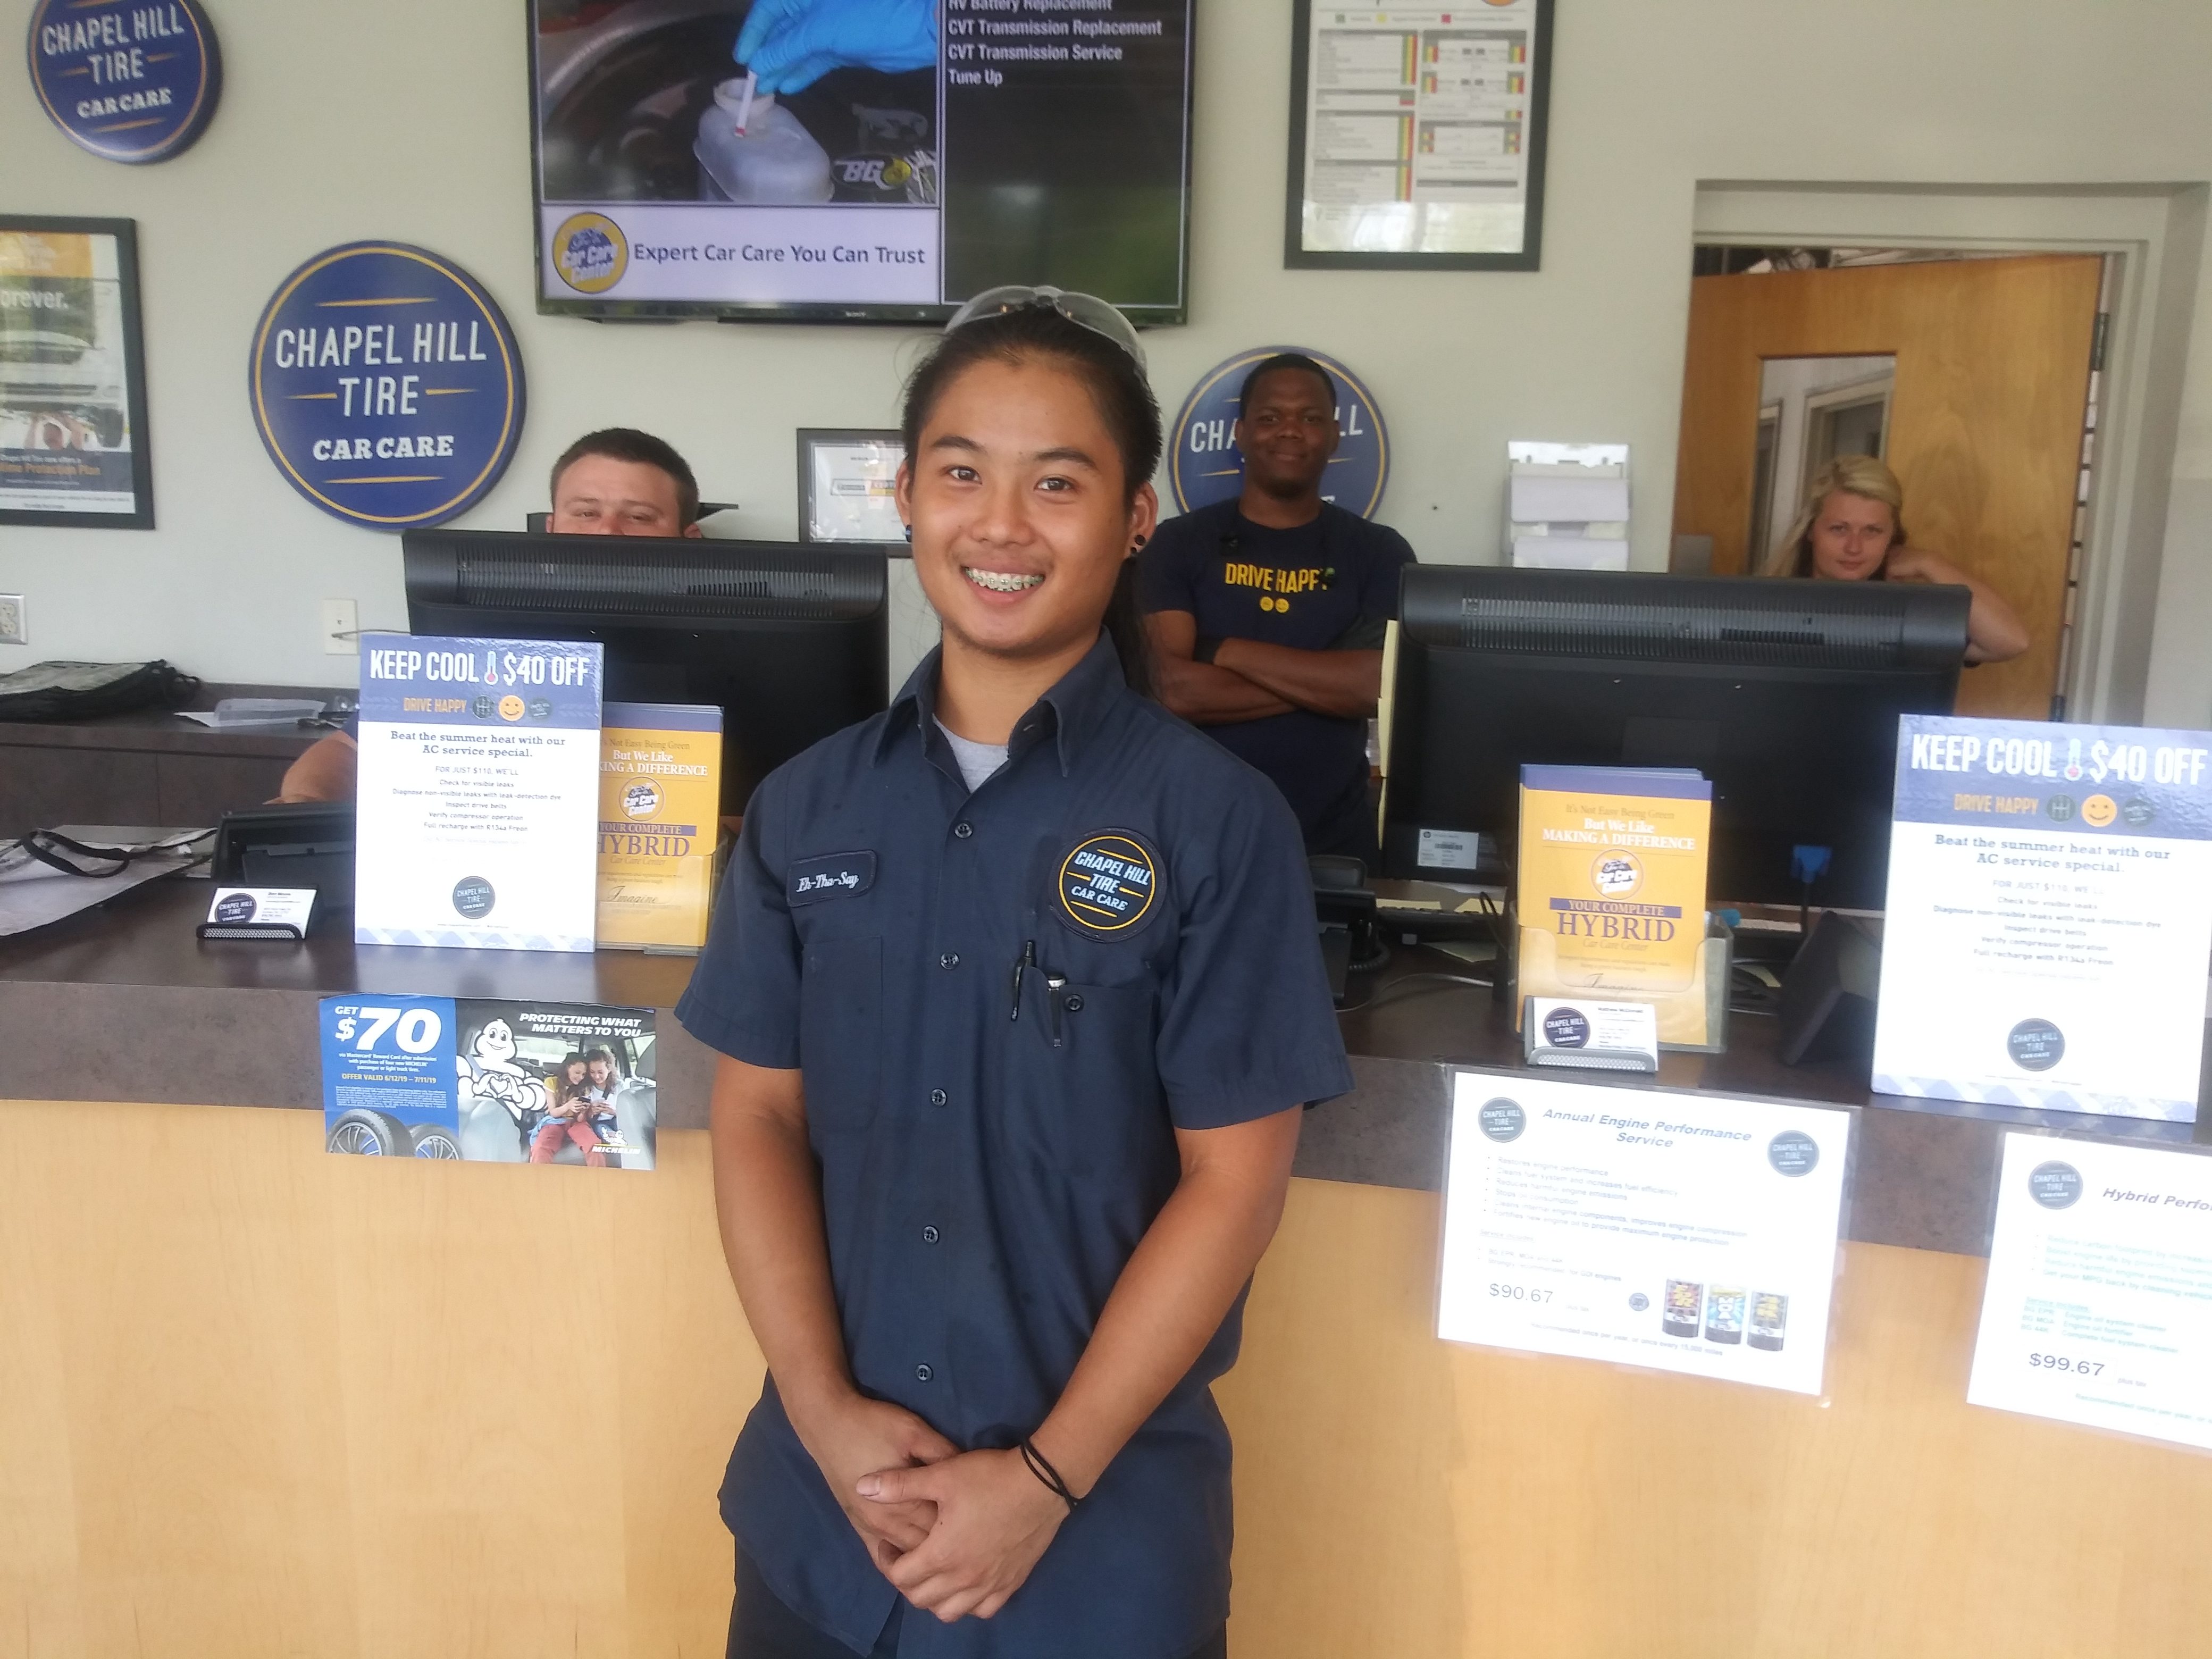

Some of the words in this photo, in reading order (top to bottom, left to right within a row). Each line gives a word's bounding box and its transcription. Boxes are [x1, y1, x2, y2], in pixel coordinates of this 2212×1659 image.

[1023, 0, 1112, 13] Replacement
[42, 13, 130, 55] CHAPEL
[133, 3, 185, 40] HILL
[948, 19, 974, 35] CVT
[977, 19, 1069, 35] Transmission
[1072, 19, 1162, 38] Replacement
[948, 44, 975, 60] CVT
[977, 44, 1069, 60] Transmission
[1071, 43, 1123, 60] Service
[88, 47, 144, 84] TIRE
[948, 69, 981, 85] Tune
[984, 69, 1003, 87] Up
[77, 97, 117, 118] CAR
[119, 87, 172, 111] CARE
[634, 243, 698, 264] Expert
[705, 245, 735, 262] Car
[742, 245, 785, 262] Care
[789, 245, 826, 263] You
[832, 246, 869, 263] Can
[875, 246, 926, 264] Trust
[275, 325, 403, 368] CHAPEL
[413, 320, 487, 363] HILL
[338, 375, 419, 416] TIRE
[313, 439, 372, 460] CAR
[375, 435, 455, 459] CARE
[1225, 563, 1273, 591] DRIVE
[370, 649, 422, 680] KEEP
[426, 651, 479, 682] COOL
[503, 651, 545, 686] $40
[551, 656, 591, 686] OFF
[403, 697, 432, 712] DRIVE
[435, 699, 467, 713] HAPPY
[391, 731, 416, 741] Beat
[419, 732, 437, 742] the
[440, 734, 488, 743] summer
[491, 734, 515, 744] heat
[519, 735, 543, 745] with
[423, 745, 440, 754] AC
[442, 746, 485, 756] service
[488, 747, 533, 758] special.
[613, 750, 631, 760] But
[633, 751, 649, 761] We
[651, 751, 674, 763] Like
[1911, 733, 1981, 772] KEEP
[1987, 737, 2057, 778] COOL
[2090, 739, 2147, 783] $40
[2154, 747, 2209, 785] OFF
[626, 763, 634, 773] A
[637, 763, 708, 776] DIFFERENCE
[1954, 793, 1992, 812] DRIVE
[1996, 795, 2039, 815] HAPPY
[629, 824, 682, 835] COMPLETE
[1583, 817, 1605, 830] But
[1608, 819, 1626, 832] We
[1628, 820, 1655, 834] Like
[1543, 829, 1597, 844] MAKING
[1599, 832, 1609, 844] A
[1612, 832, 1695, 850] DIFFERENCE
[1934, 834, 1968, 847] Beat
[1973, 836, 1996, 848] the
[2001, 839, 2064, 853] summer
[2070, 843, 2102, 855] heat
[2107, 845, 2139, 858] with
[2144, 850, 2171, 860] our
[1074, 851, 1125, 877] CHAPEL
[1122, 865, 1152, 886] HILL
[1977, 853, 1998, 865] AC
[2004, 854, 2060, 868] service
[2065, 857, 2125, 873] special.
[1089, 873, 1121, 894] TIRE
[608, 885, 659, 906] Imagine
[1071, 886, 1096, 900] CAR
[1096, 893, 1129, 911] CARE
[1568, 900, 1601, 912] YOUR
[1602, 903, 1665, 916] COMPLETE
[1557, 912, 1675, 942] HYBRID
[335, 1006, 359, 1015] GET
[520, 1013, 600, 1026] PROTECTING
[601, 1017, 642, 1028] WHAT
[335, 1007, 442, 1054] $70
[532, 1024, 593, 1036] MATTERS
[594, 1027, 611, 1036] TO
[614, 1028, 642, 1037] YOU
[1542, 1108, 1596, 1124] Annual
[1599, 1113, 1650, 1133] Engine
[1654, 1120, 1753, 1142] Performance
[592, 1146, 641, 1155] MICHELIN
[1615, 1132, 1674, 1148] Service
[2102, 1187, 2160, 1203] Hybrid
[1489, 1283, 1553, 1303] $90.67
[2029, 1352, 2106, 1376] $99.67
